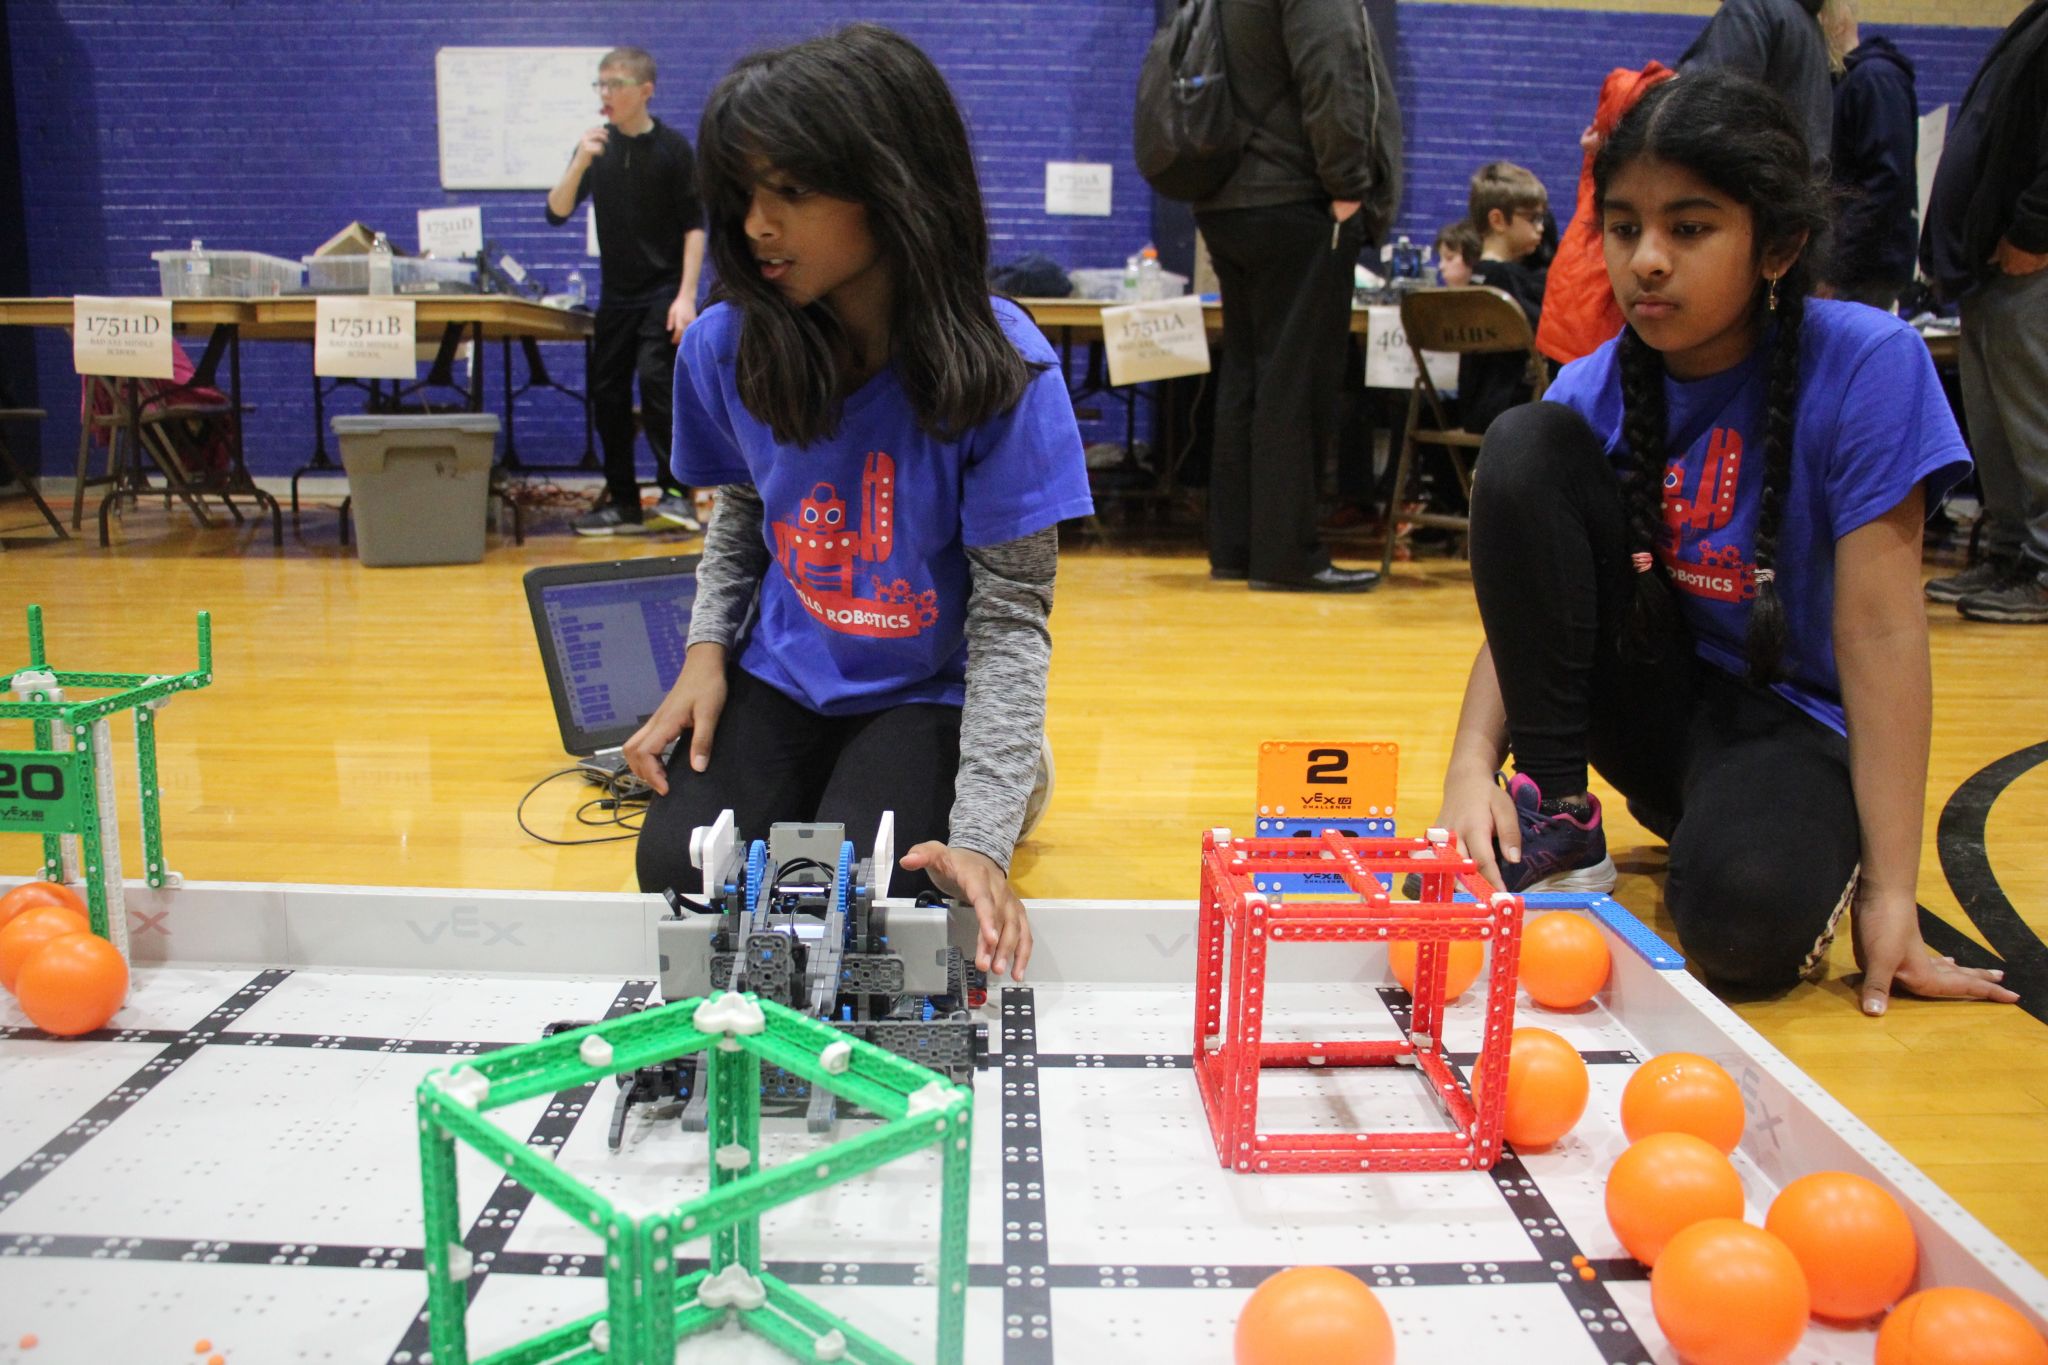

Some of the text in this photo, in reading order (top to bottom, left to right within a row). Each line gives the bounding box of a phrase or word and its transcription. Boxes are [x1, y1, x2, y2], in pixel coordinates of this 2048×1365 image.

[87, 315, 160, 337] 17511D
[329, 315, 401, 338] 17511B
[1123, 313, 1185, 339] 17511A
[1377, 327, 1407, 351] 46
[1665, 565, 1733, 592] OBOTICS
[826, 609, 911, 628] ROBOTICS
[1307, 749, 1349, 784] 2
[1301, 792, 1336, 804] VEX
[405, 905, 526, 946] VEX
[1736, 1067, 1783, 1151] EX
